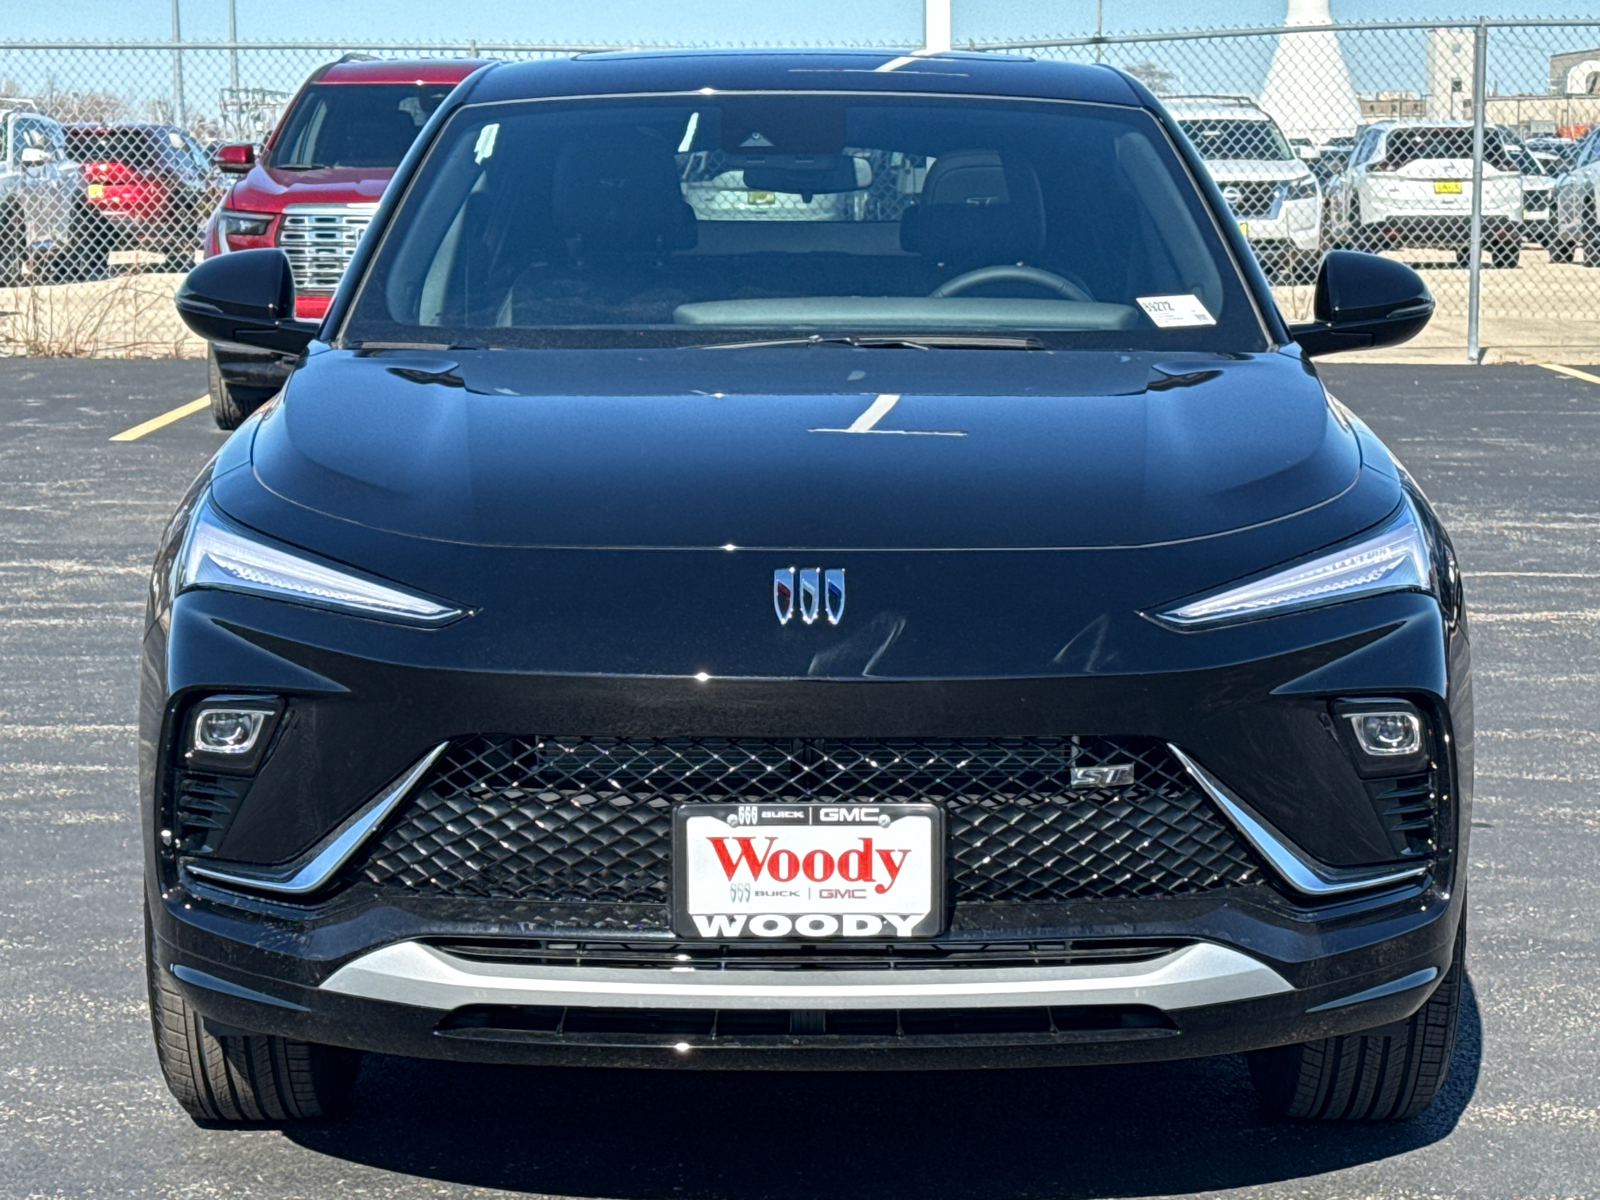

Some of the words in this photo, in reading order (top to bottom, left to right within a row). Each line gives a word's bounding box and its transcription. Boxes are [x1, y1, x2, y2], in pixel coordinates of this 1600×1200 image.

[1071, 766, 1131, 786] ST
[761, 810, 805, 819] BUICK
[819, 807, 880, 822] GMC
[706, 836, 912, 894] Woody
[818, 888, 867, 899] GMC
[692, 914, 926, 938] WOODY
